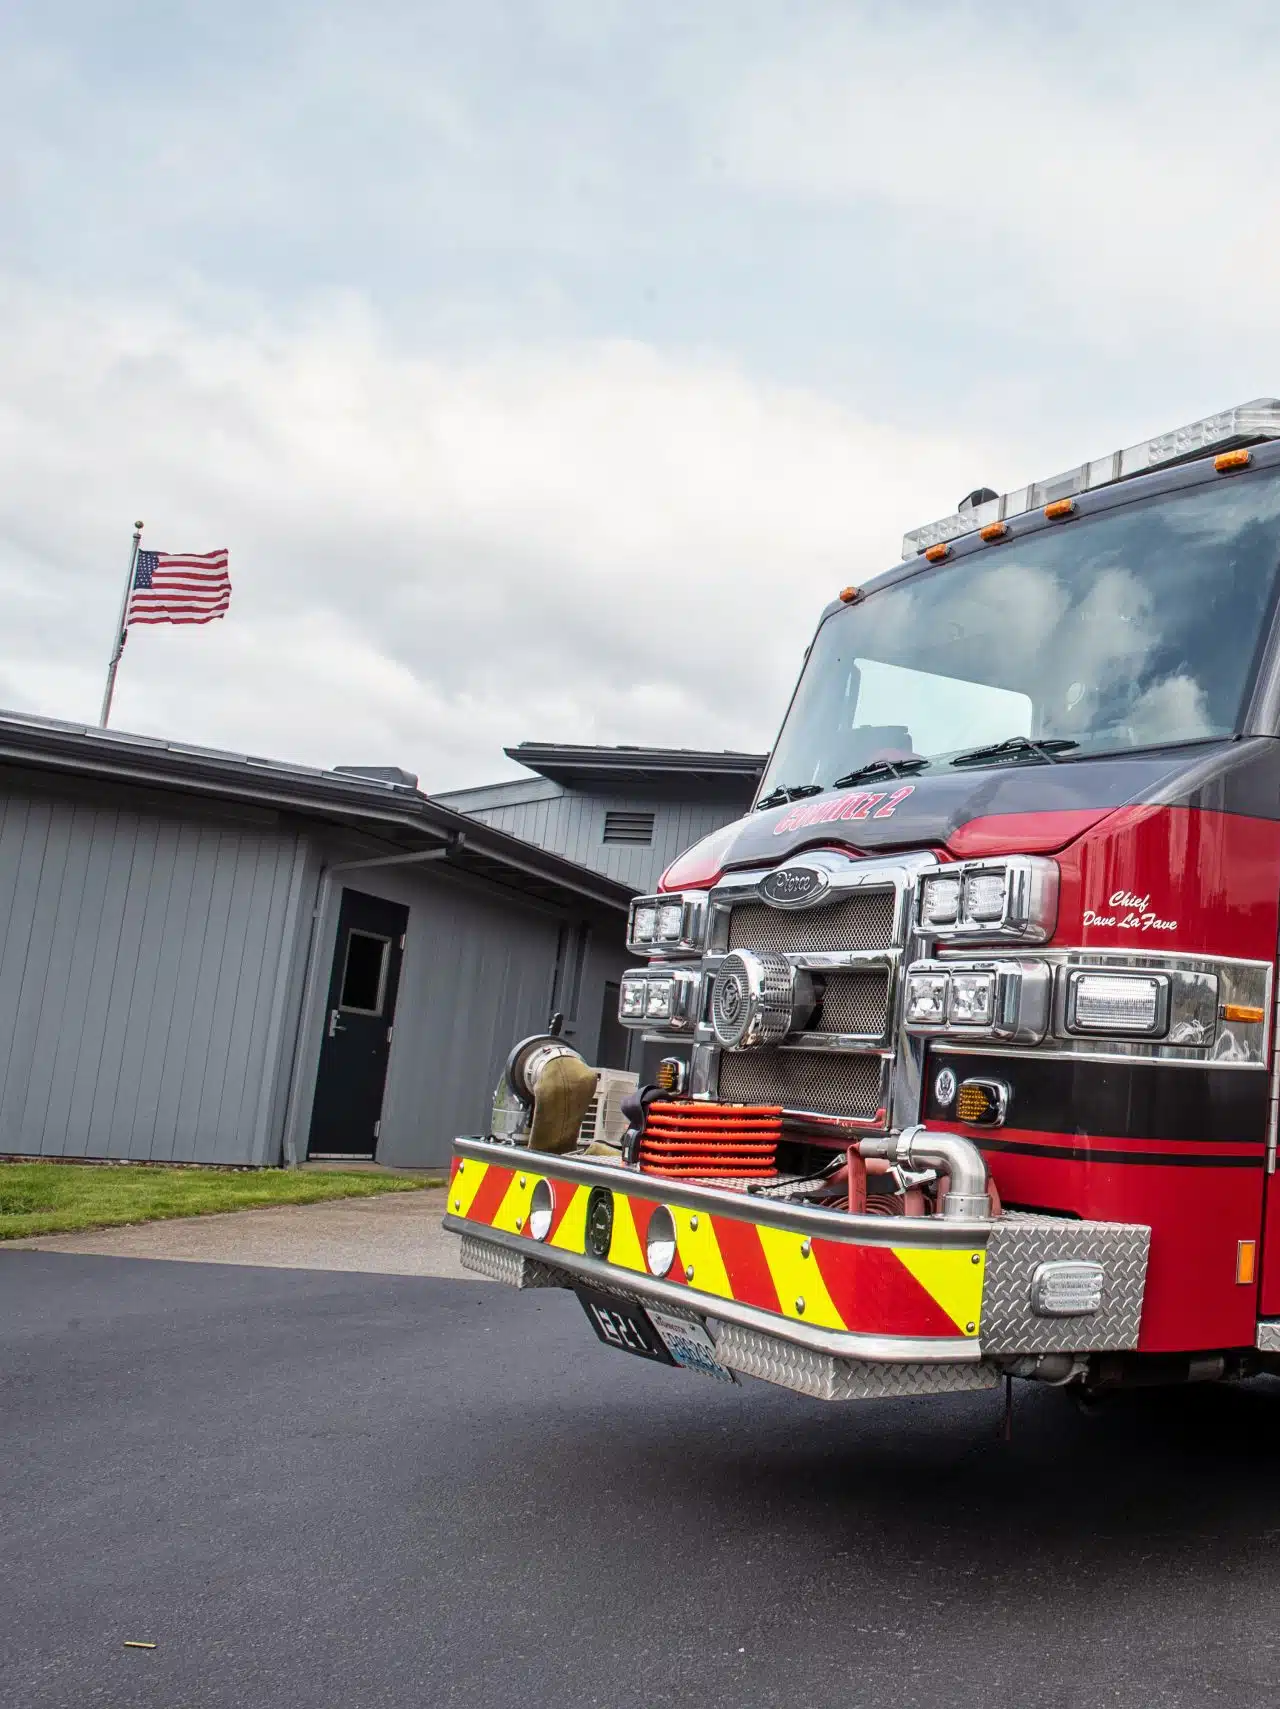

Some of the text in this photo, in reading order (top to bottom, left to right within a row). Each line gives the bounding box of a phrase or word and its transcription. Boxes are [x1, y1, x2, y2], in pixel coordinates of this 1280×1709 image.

[873, 786, 915, 818] 2
[774, 871, 811, 894] Pierce
[1109, 890, 1150, 913] Chief
[1083, 911, 1116, 926] Dave
